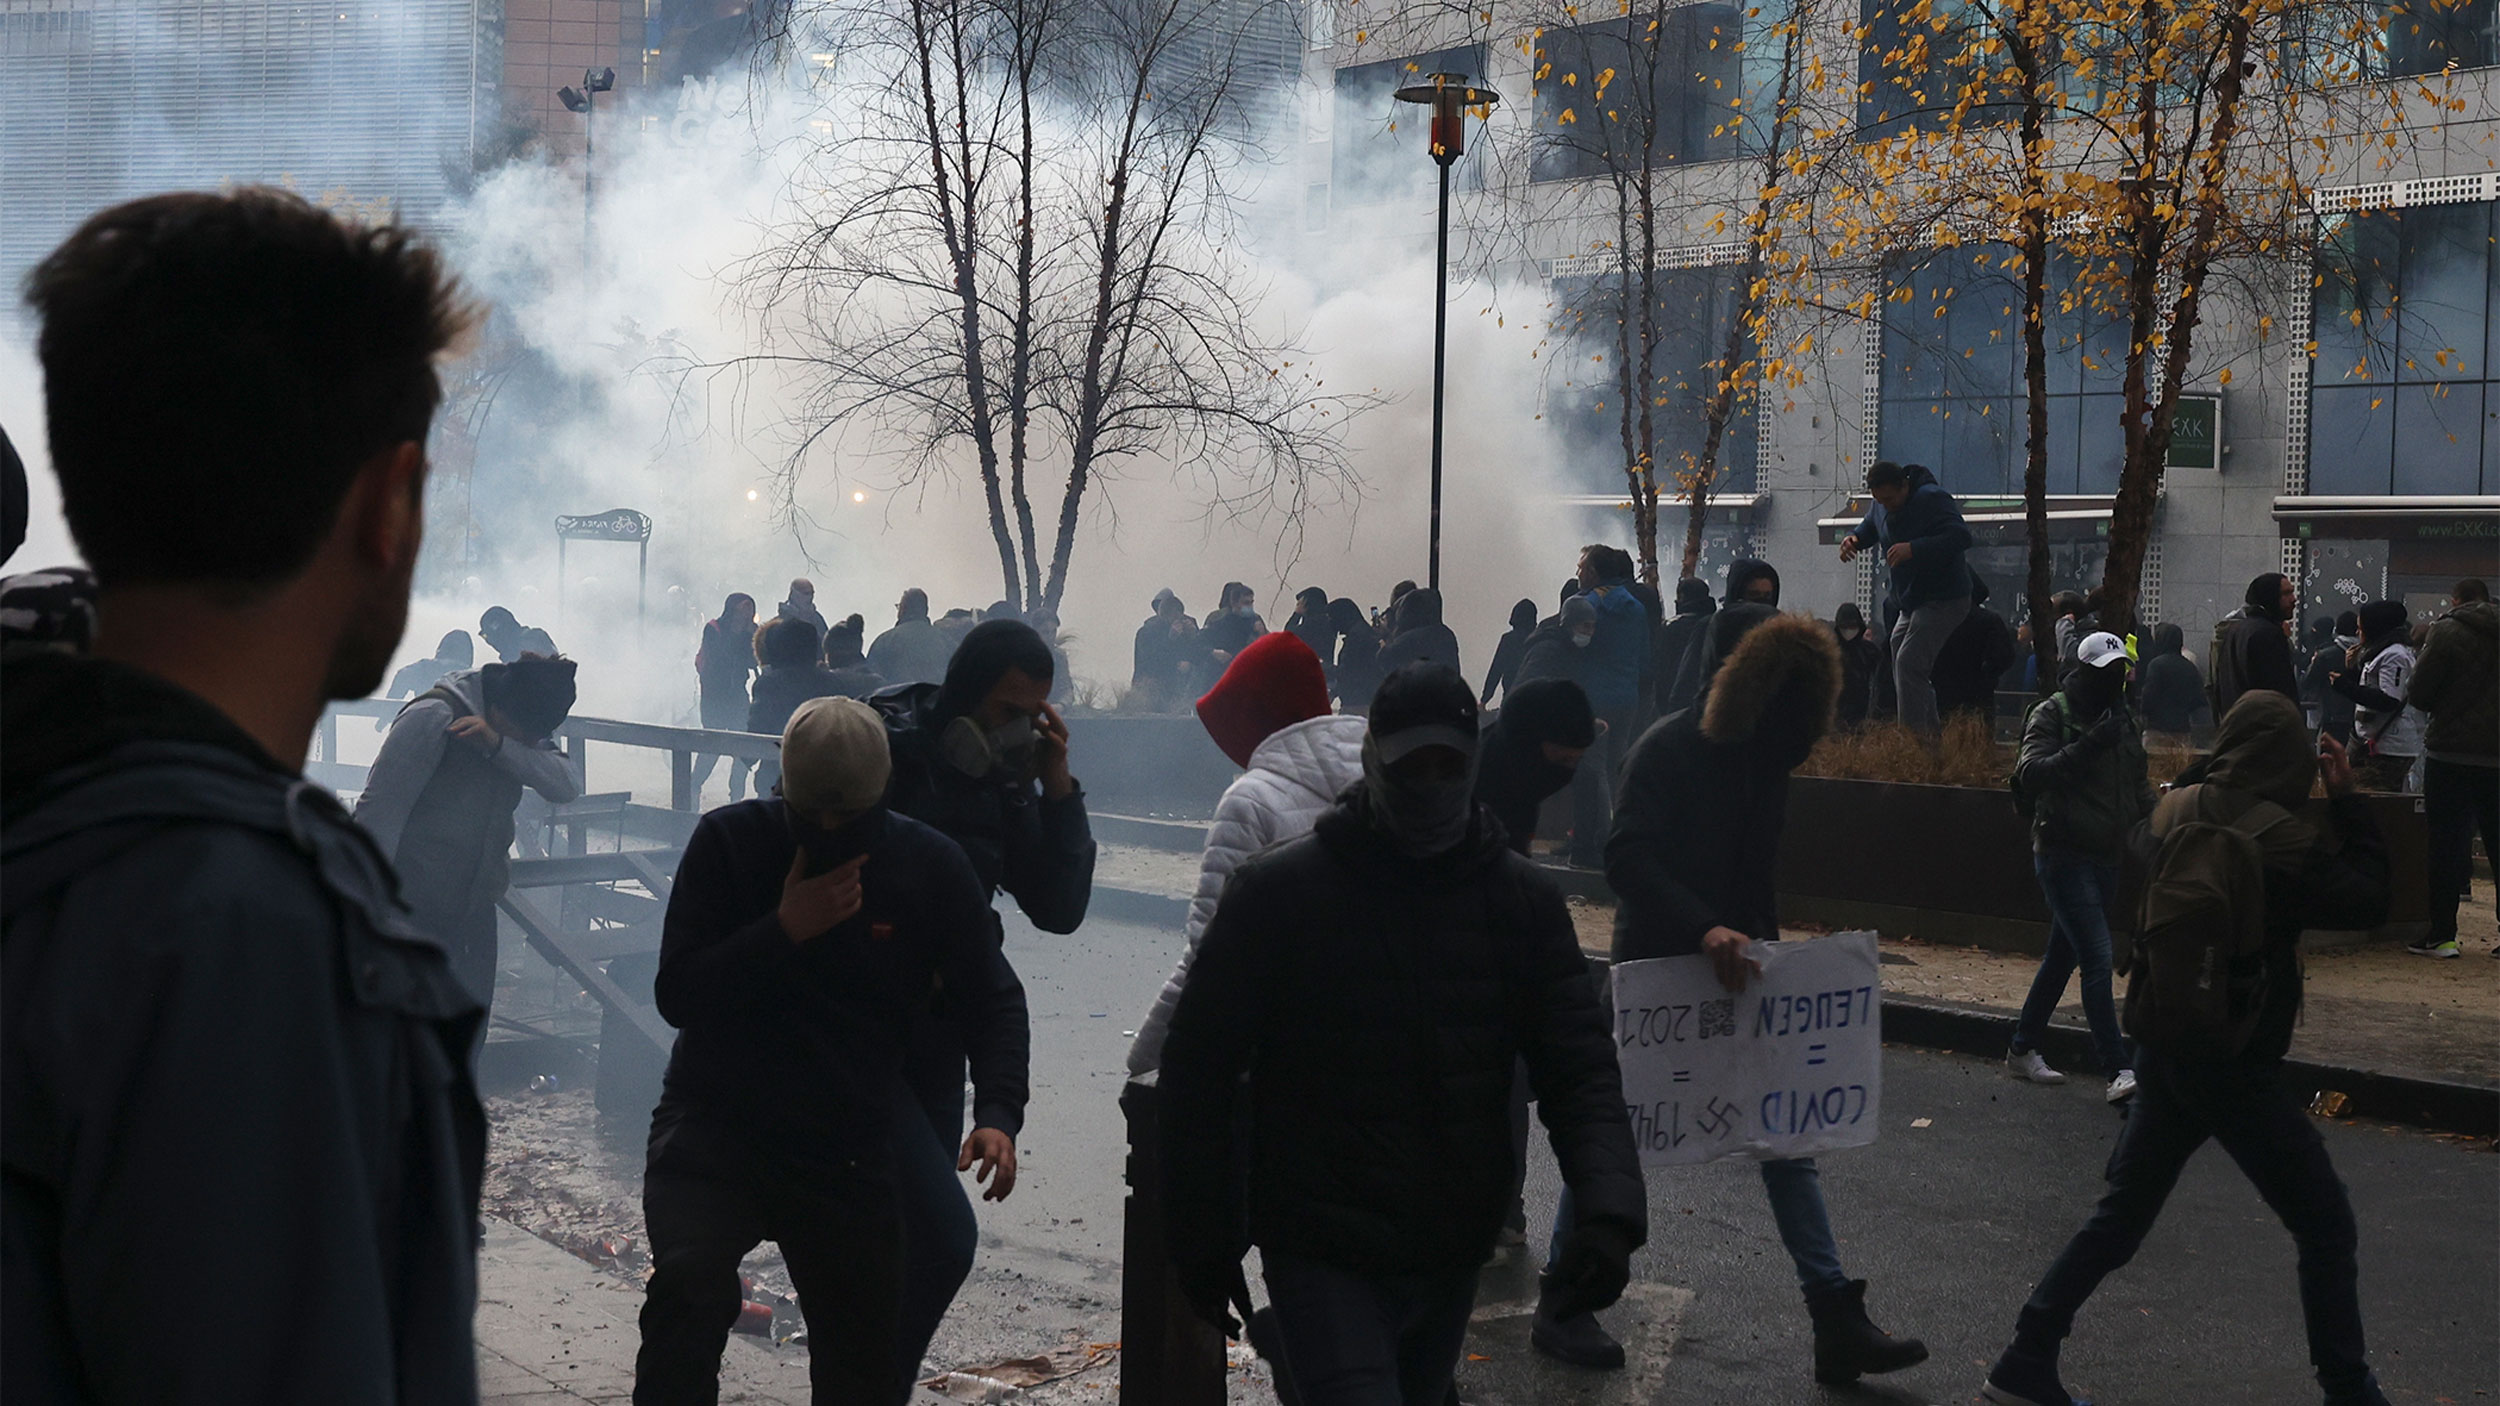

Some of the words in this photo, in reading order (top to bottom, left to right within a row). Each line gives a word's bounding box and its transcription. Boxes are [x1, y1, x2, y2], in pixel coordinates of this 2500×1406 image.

[1620, 1004, 1692, 1047] 2021
[1754, 986, 1871, 1038] LEUGEN
[1761, 1084, 1868, 1134] COVID
